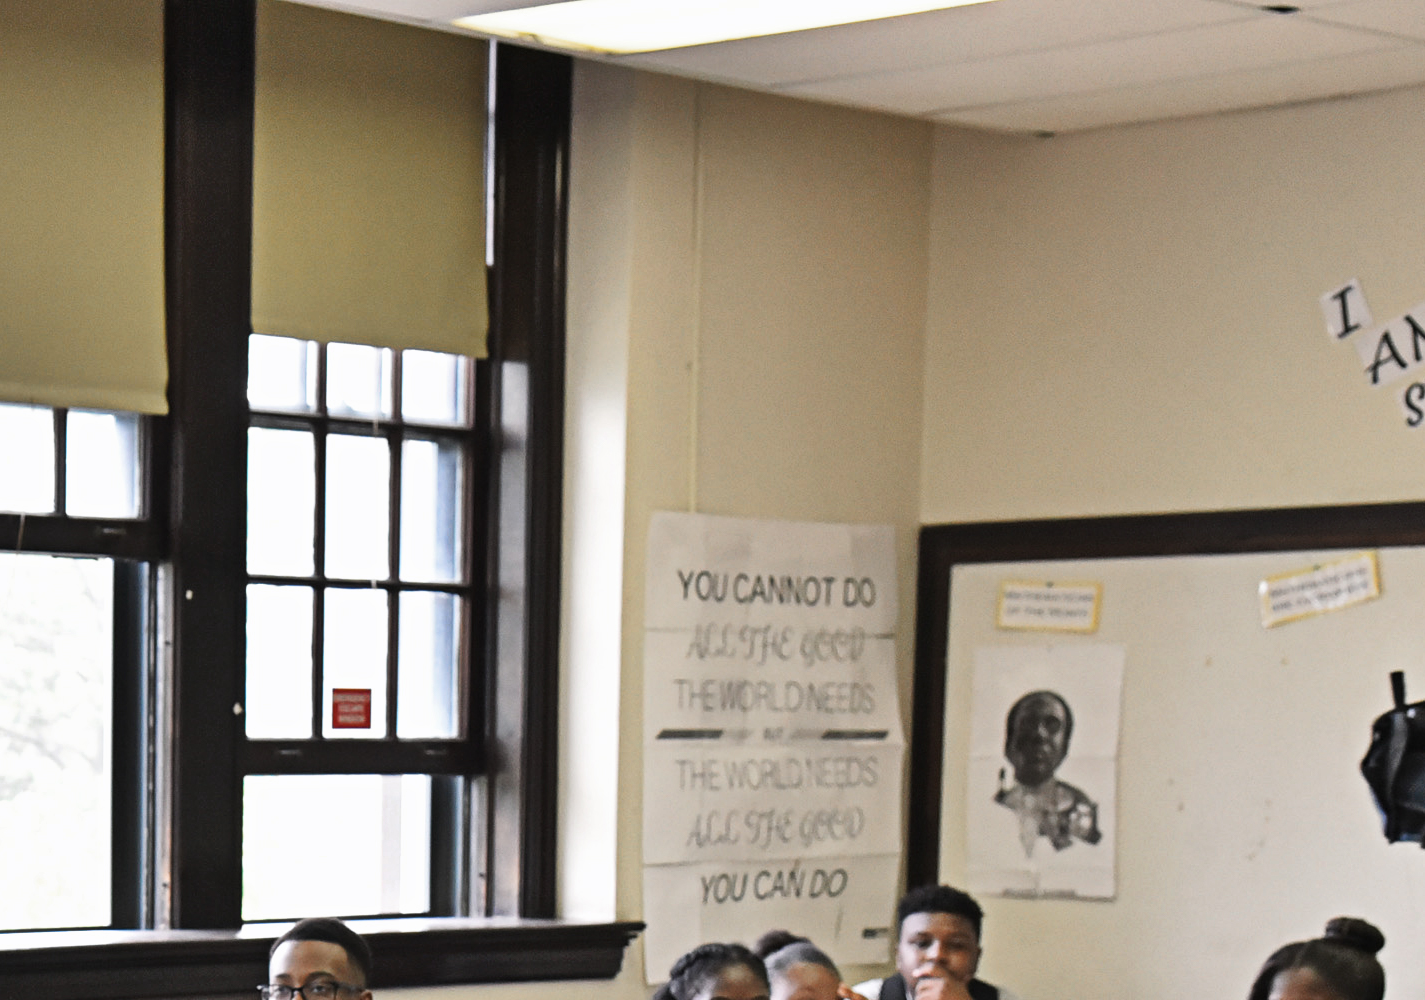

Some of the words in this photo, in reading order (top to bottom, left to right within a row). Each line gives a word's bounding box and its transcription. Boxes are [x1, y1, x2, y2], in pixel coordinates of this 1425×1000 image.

[1330, 285, 1361, 339] I
[677, 569, 729, 602] YOU
[732, 572, 835, 606] CANNOT
[842, 576, 876, 608] DO
[673, 678, 717, 712] THE
[719, 678, 804, 713] WORLD
[806, 680, 876, 714] NEEDS
[675, 758, 721, 791] THE
[723, 757, 802, 791] WORLD
[804, 755, 879, 789] NEEDS
[701, 872, 748, 905] YOU
[754, 868, 806, 901] CAN
[809, 867, 848, 899] DO
